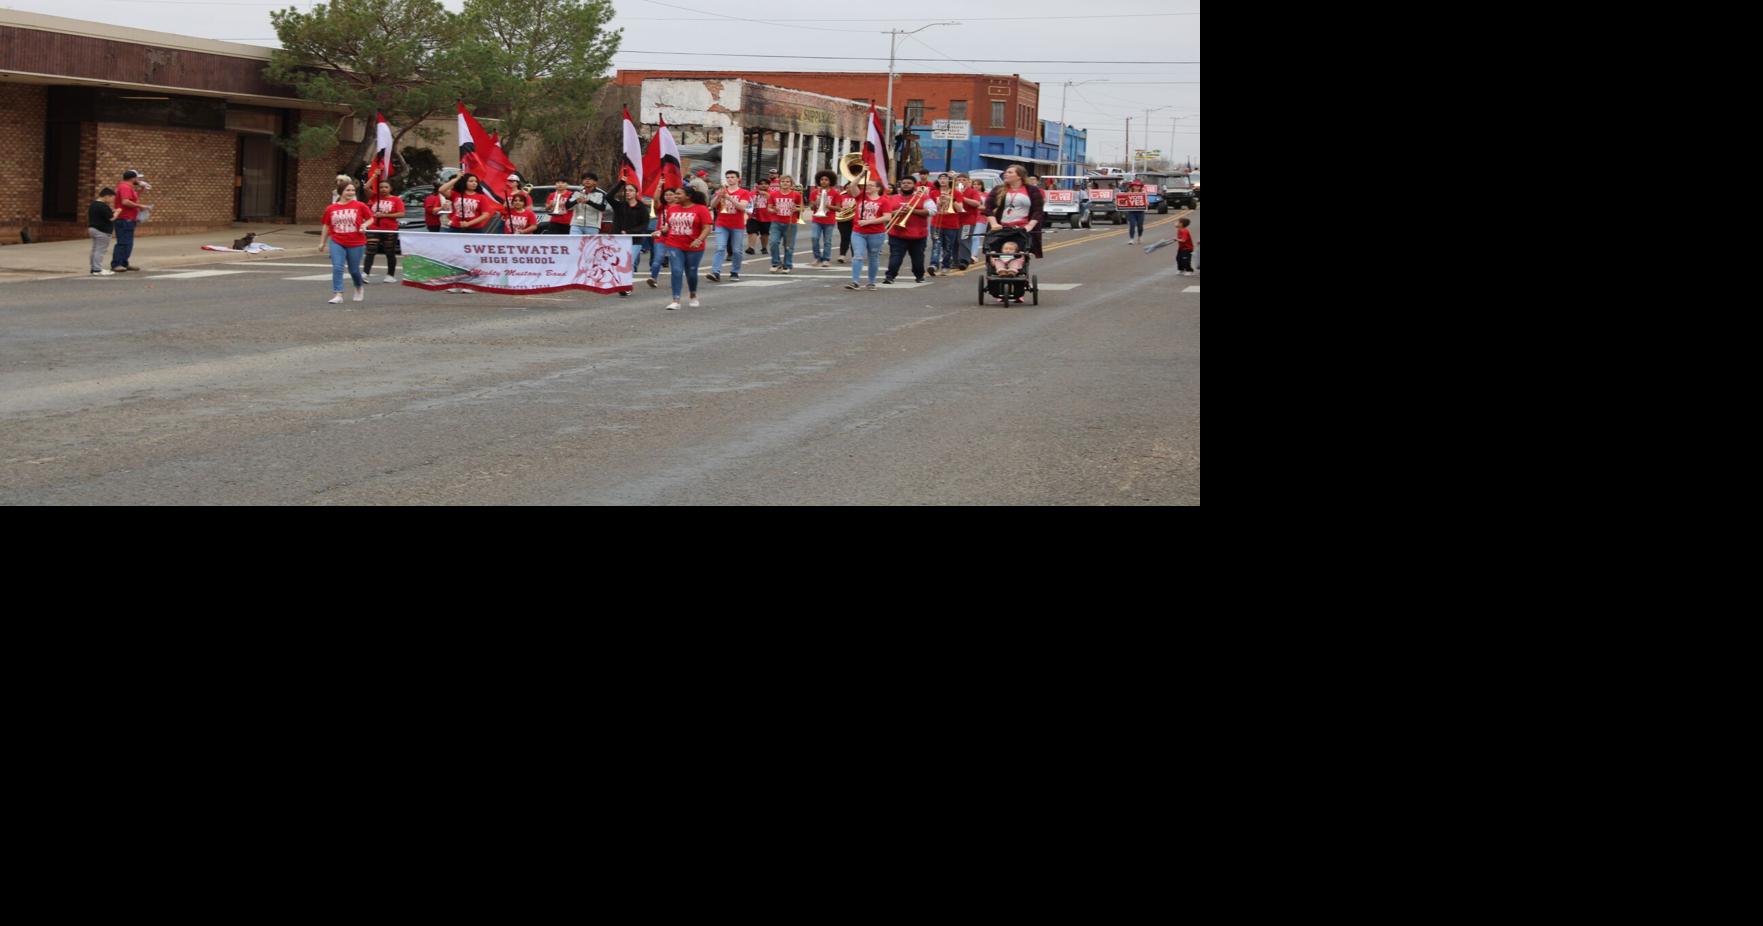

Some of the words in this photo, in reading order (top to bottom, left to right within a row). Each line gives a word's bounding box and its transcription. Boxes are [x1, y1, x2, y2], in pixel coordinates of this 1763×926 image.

[463, 244, 570, 255] SWEETWATER
[480, 256, 508, 264] HIGH
[512, 256, 555, 264] SCHOOL
[504, 269, 541, 278] Mustang
[544, 269, 568, 277] Band
